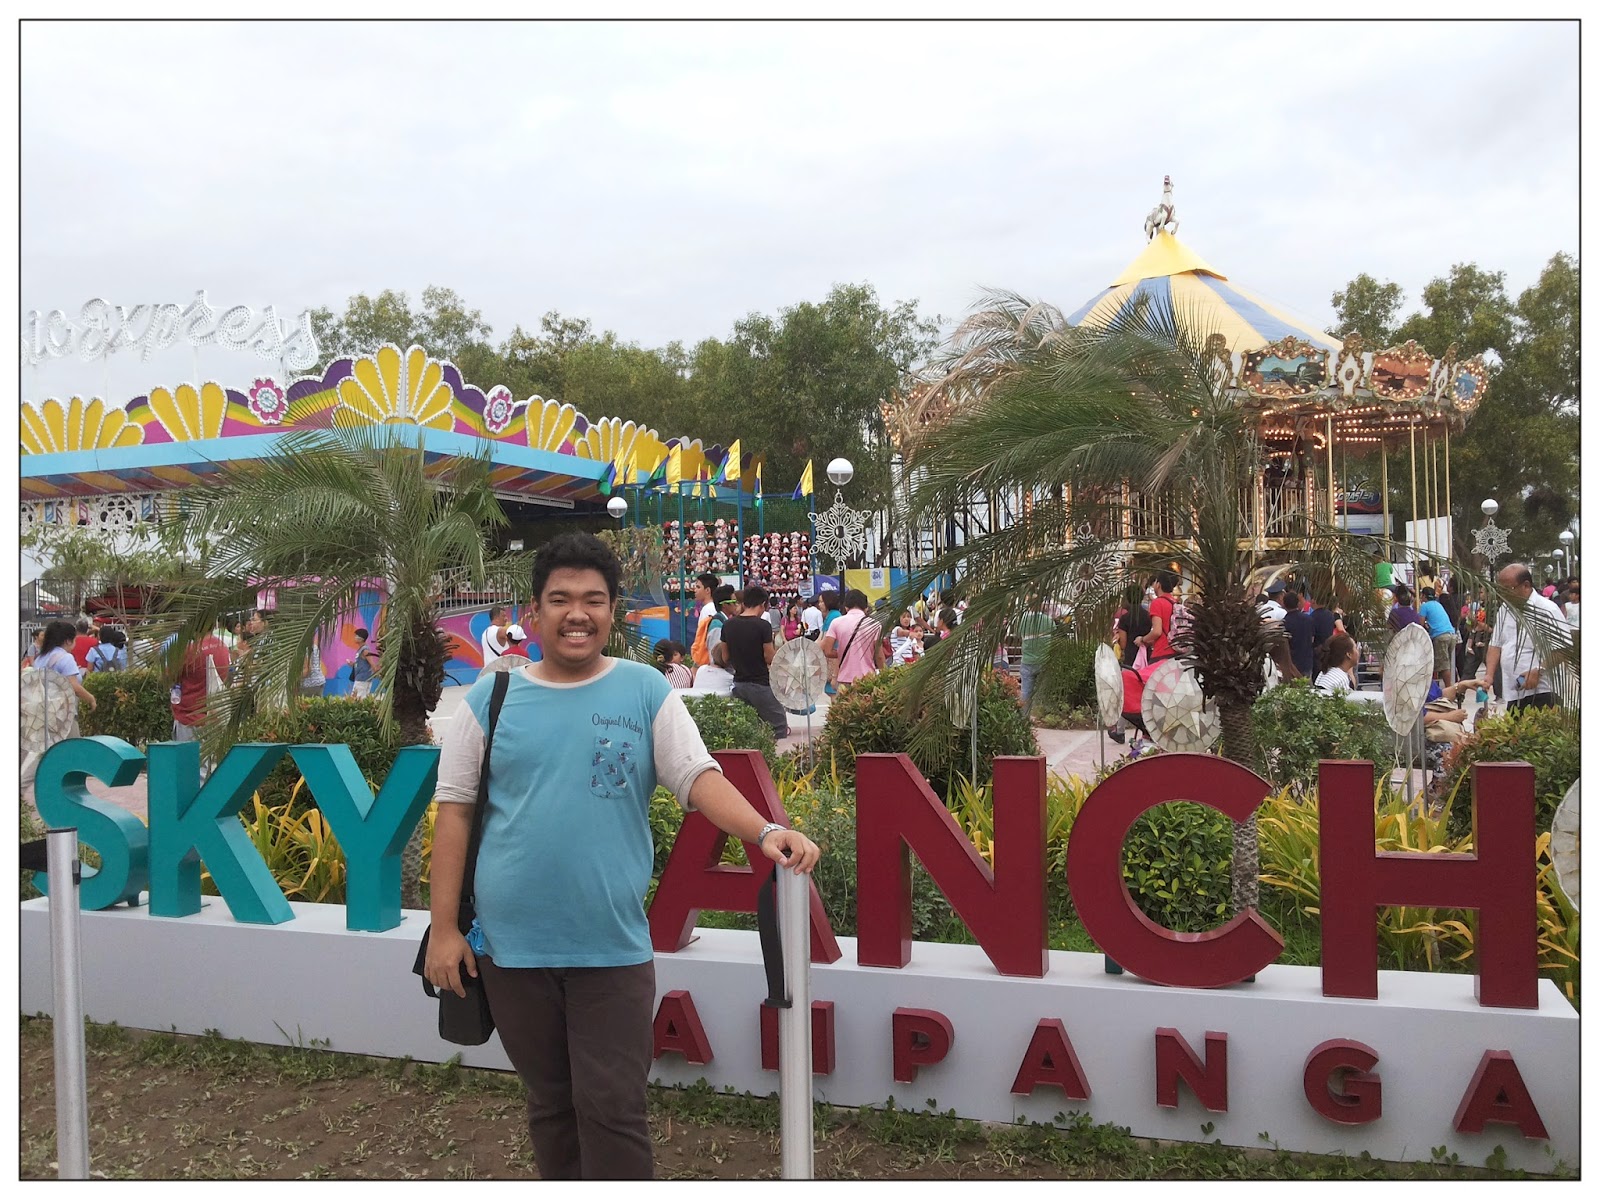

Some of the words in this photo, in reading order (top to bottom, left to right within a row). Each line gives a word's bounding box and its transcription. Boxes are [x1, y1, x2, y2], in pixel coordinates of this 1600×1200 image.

[592, 712, 621, 730] Original
[622, 716, 644, 741] Mickey
[32, 735, 441, 932] SKY
[648, 749, 1539, 1010] ANCH
[652, 989, 1550, 1141] APANGA
